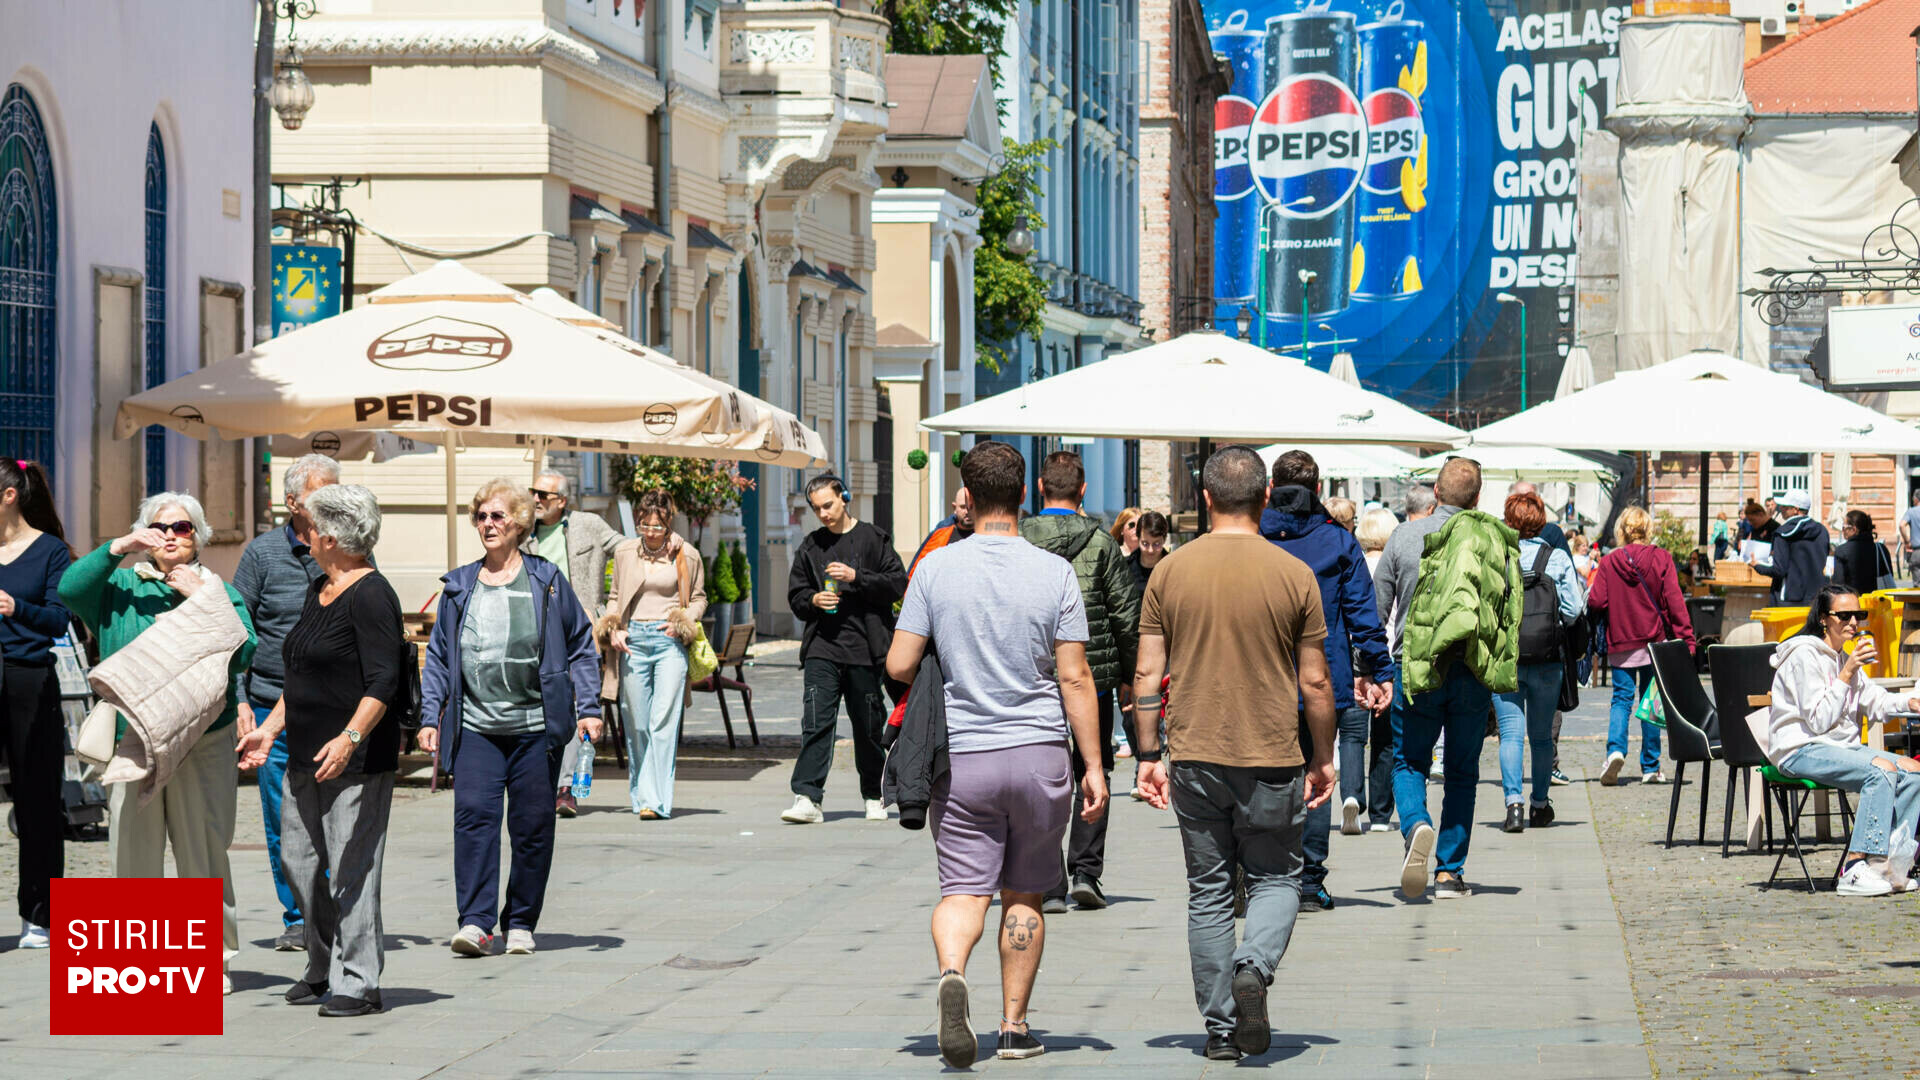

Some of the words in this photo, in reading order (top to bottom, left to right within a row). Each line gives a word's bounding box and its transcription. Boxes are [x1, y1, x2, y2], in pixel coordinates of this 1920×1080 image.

[1257, 130, 1360, 161] PEPSI
[1492, 204, 1532, 251] UN
[1541, 202, 1577, 249] N
[1272, 239, 1302, 249] ZERO
[374, 336, 505, 356] PEPSI
[354, 393, 492, 426] PEPSI
[645, 413, 677, 425] PEPSI
